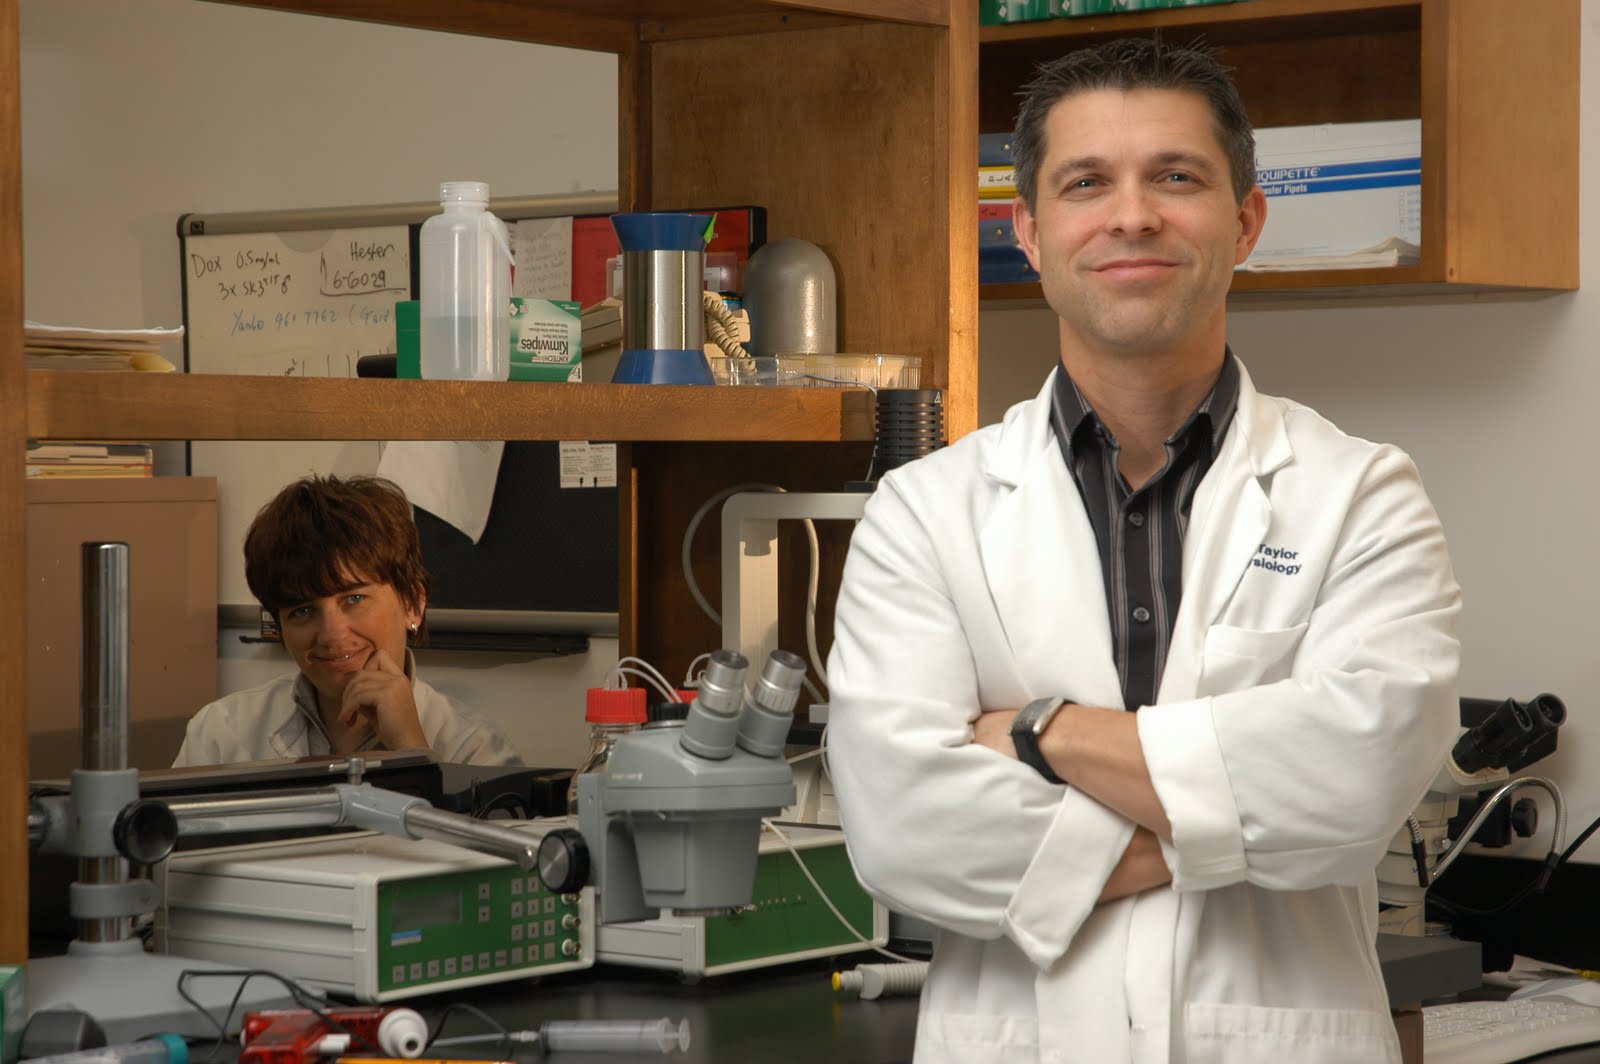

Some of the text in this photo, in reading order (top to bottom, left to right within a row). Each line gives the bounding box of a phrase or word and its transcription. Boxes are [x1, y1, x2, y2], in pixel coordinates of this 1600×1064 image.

[1256, 167, 1319, 182] IQUIPETTE
[190, 253, 222, 278] Dox
[333, 269, 386, 289] 6-6029
[521, 336, 569, 355] Kimwipes
[1258, 544, 1298, 559] Taylor
[1252, 558, 1302, 575] siology
